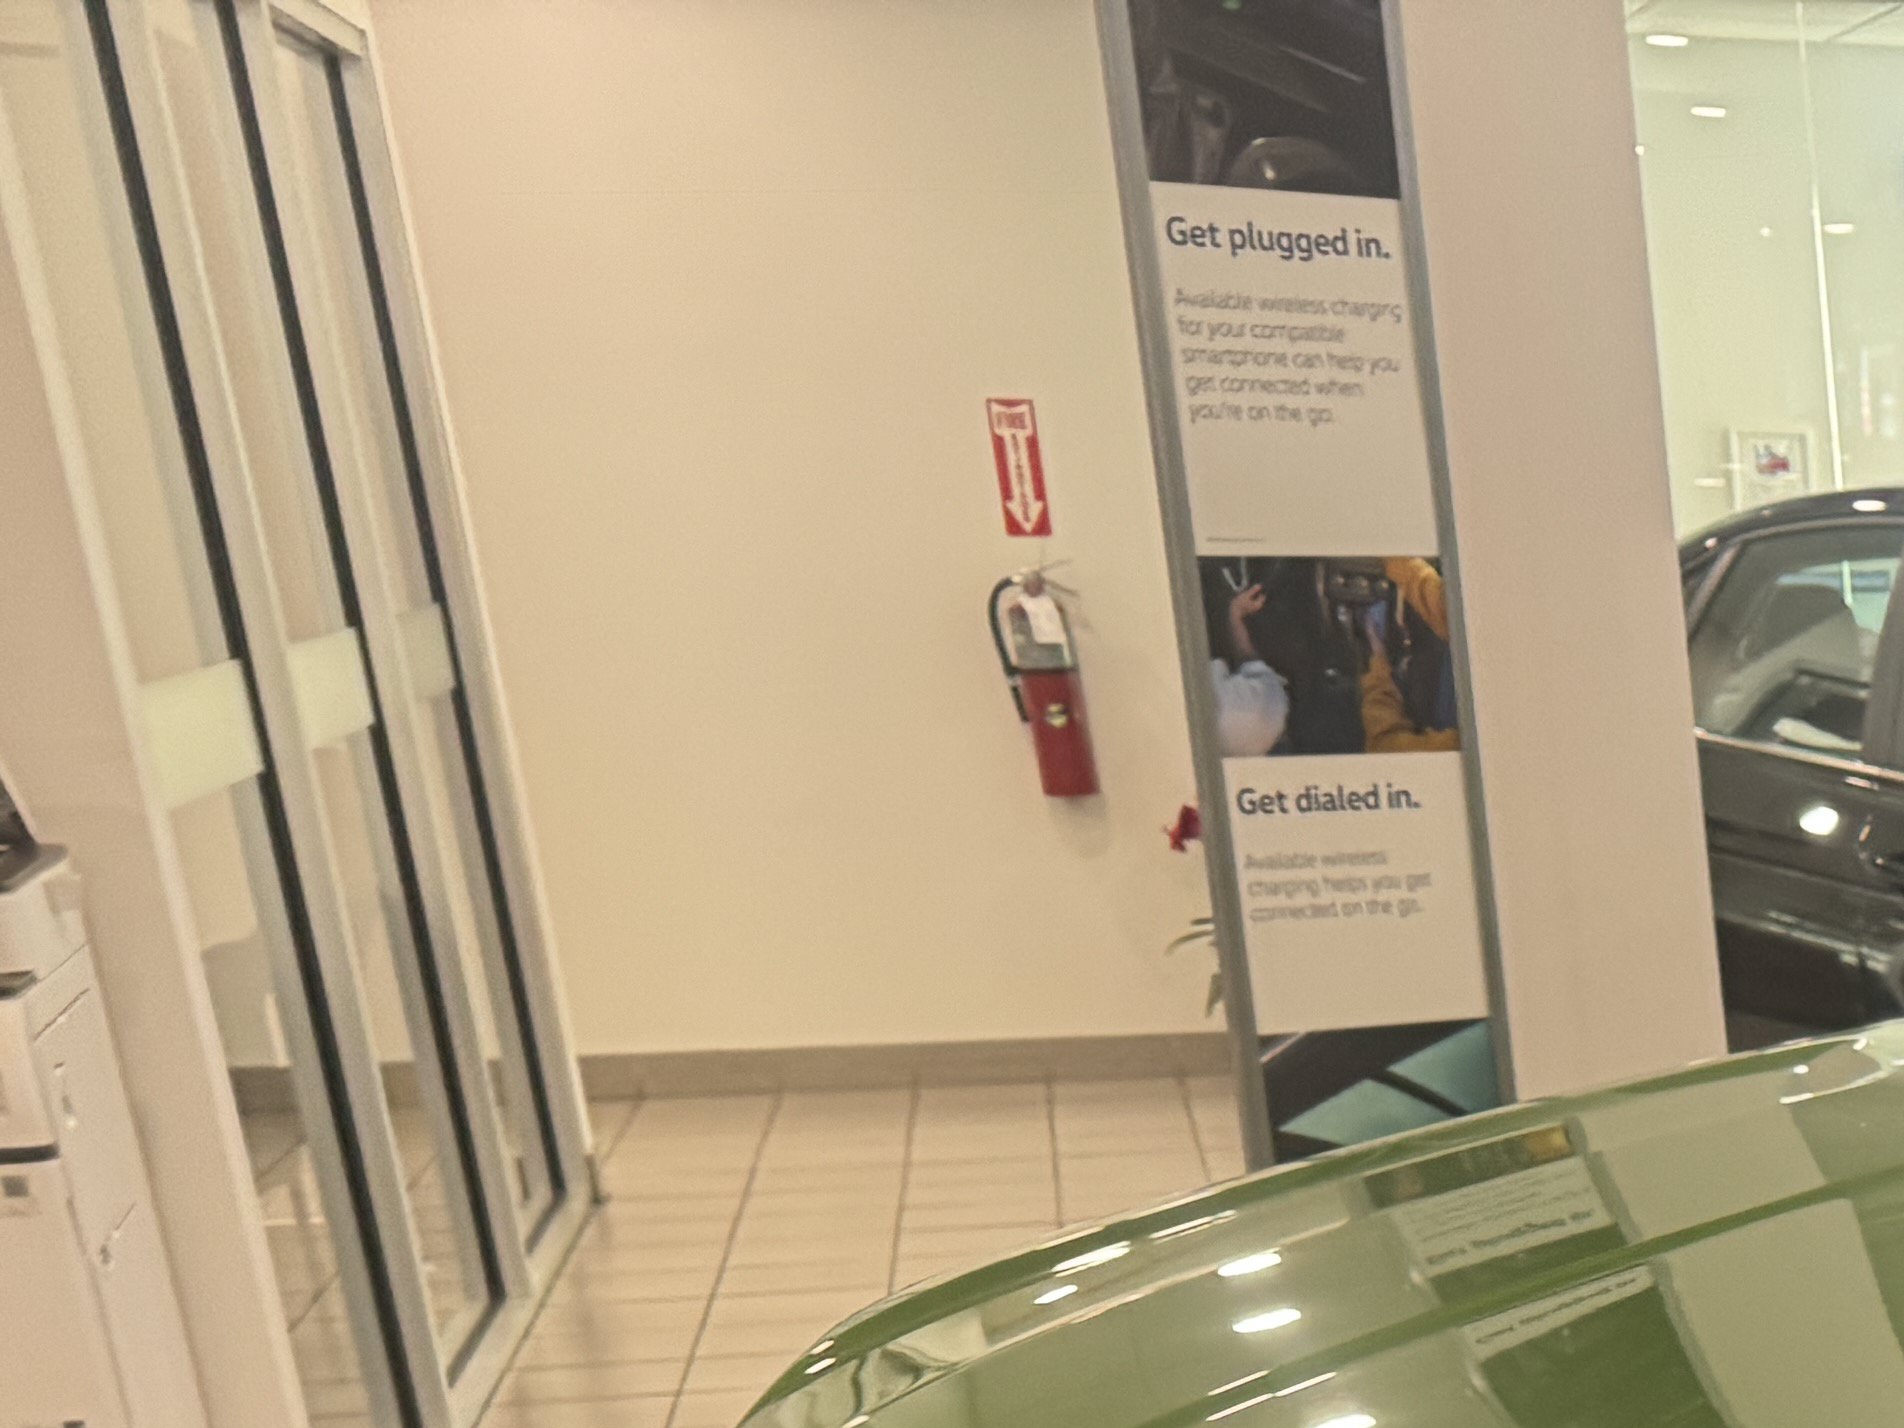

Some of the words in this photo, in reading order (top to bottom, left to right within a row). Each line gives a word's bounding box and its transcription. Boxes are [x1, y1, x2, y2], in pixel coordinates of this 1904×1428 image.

[1166, 216, 1221, 248] Get
[1228, 221, 1349, 261] plugged
[1354, 228, 1391, 259] in.
[1236, 787, 1289, 815] Get
[1295, 783, 1381, 813] dialed
[1386, 781, 1422, 809] in.
